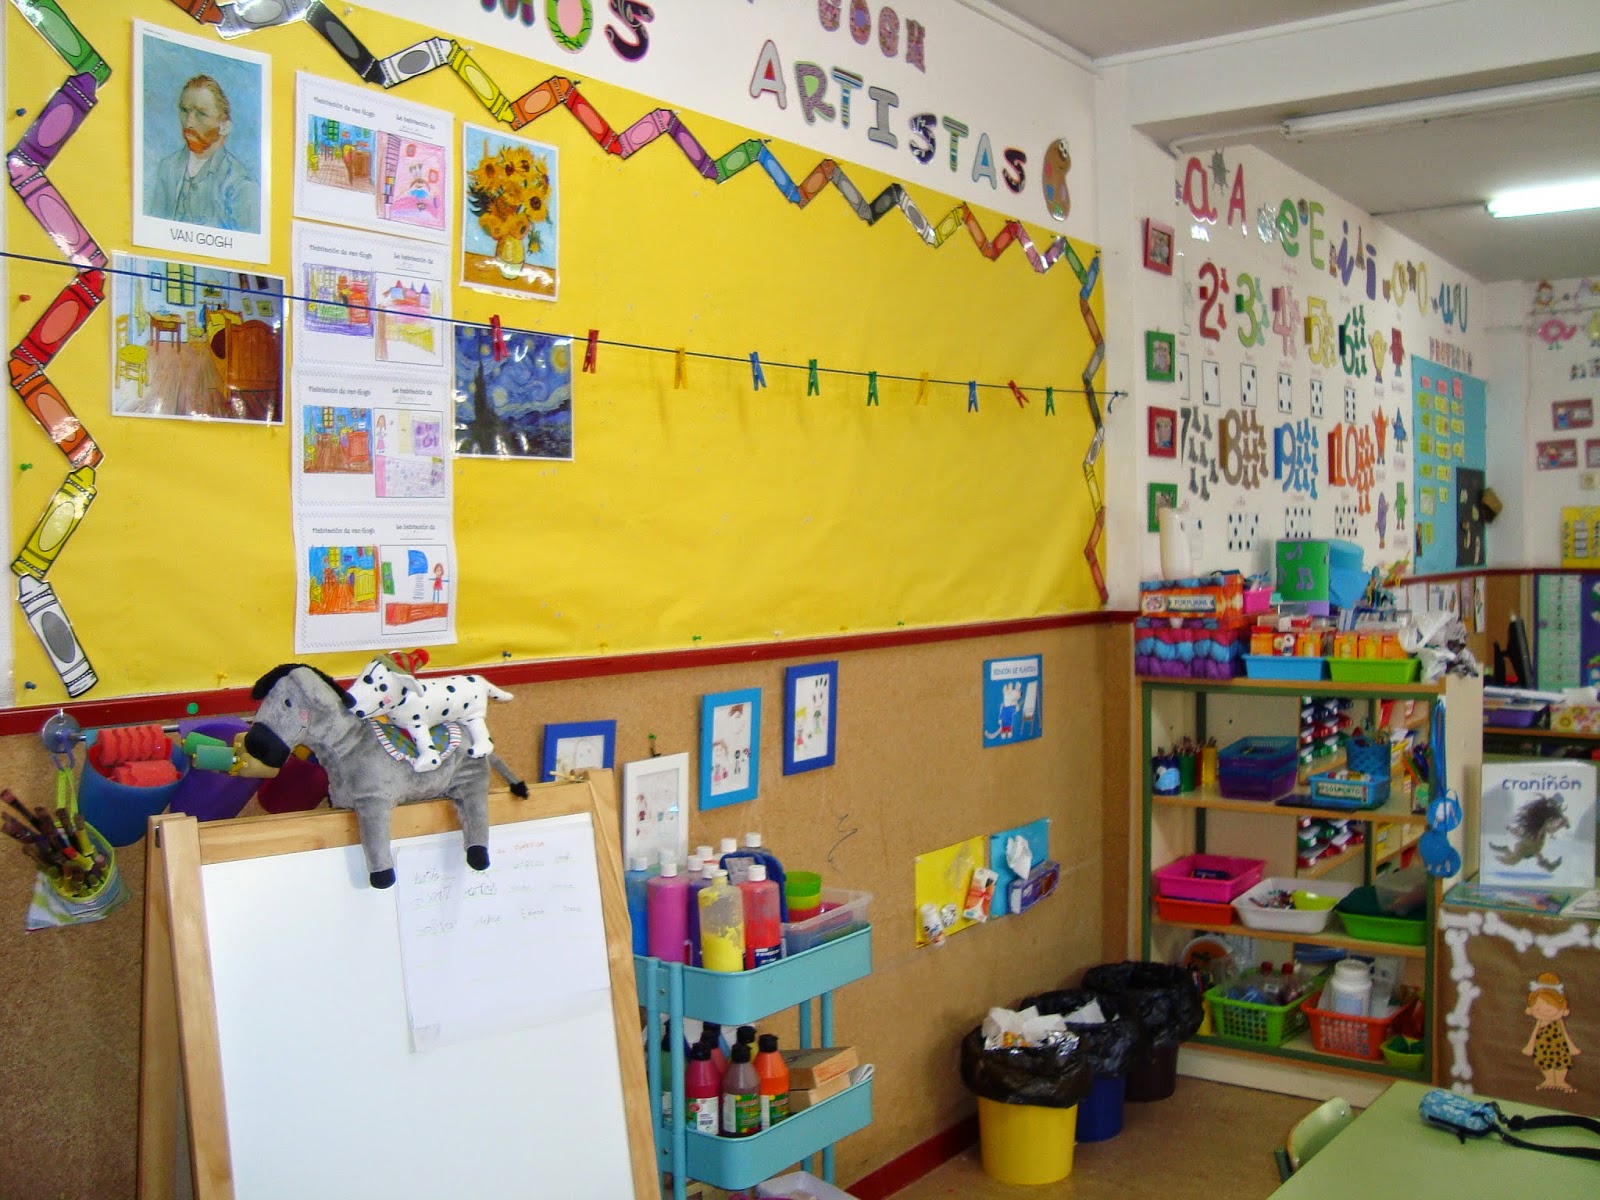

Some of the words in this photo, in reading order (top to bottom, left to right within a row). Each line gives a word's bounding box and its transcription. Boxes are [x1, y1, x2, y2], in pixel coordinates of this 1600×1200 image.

[750, 39, 1027, 194] ARTISTAS
[170, 228, 194, 242] VAN
[196, 232, 233, 248] GOGH
[1227, 163, 1247, 238] A
[1276, 199, 1300, 257] e
[1309, 202, 1325, 270] E
[1199, 262, 1220, 342] 2
[1237, 273, 1258, 348] 3
[1273, 286, 1291, 357] 4
[1306, 296, 1326, 364] 5
[1340, 313, 1356, 375] 6
[1181, 407, 1191, 467] 7
[1224, 408, 1243, 486] 8
[1282, 422, 1297, 492] 9
[1331, 422, 1359, 487] 10
